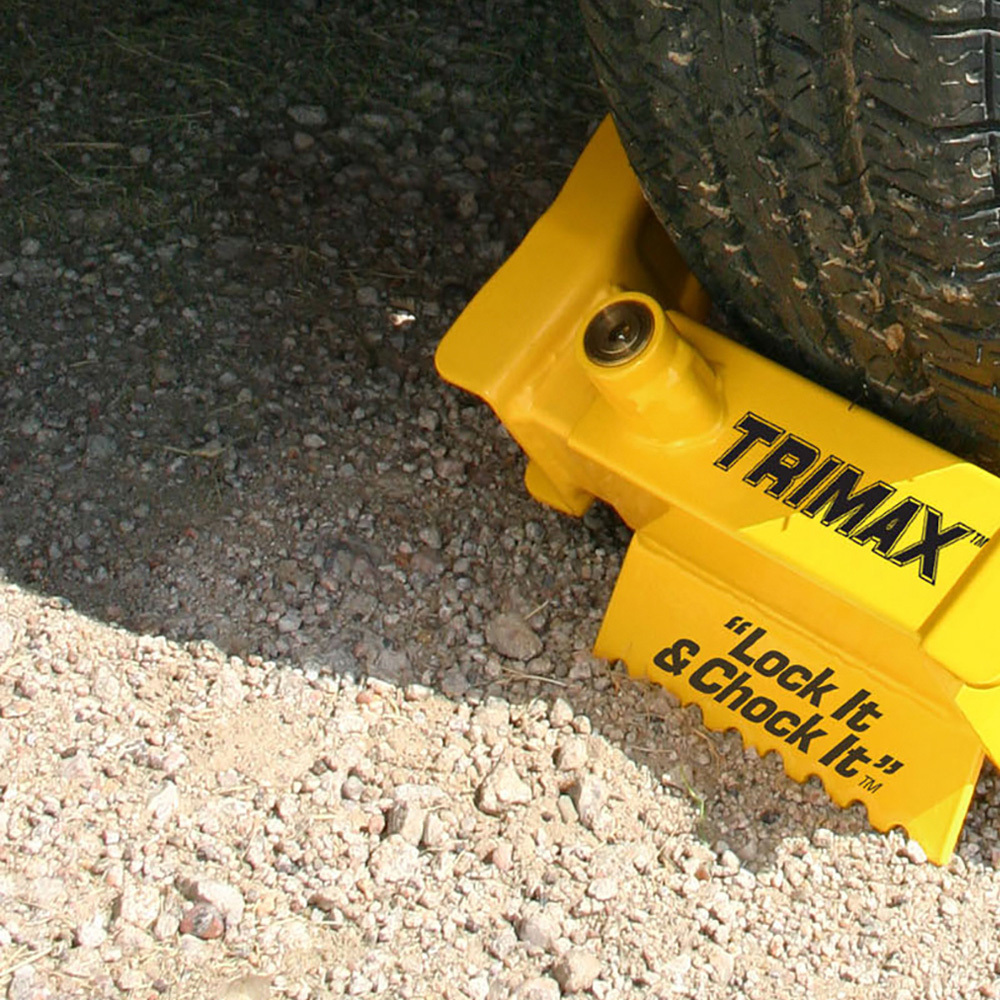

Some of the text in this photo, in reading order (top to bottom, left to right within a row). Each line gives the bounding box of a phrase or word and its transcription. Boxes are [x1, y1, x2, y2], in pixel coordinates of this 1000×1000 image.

[713, 411, 977, 586] TRIMAX
[653, 638, 701, 678] &
[688, 657, 828, 755] Chock
[830, 688, 884, 733] It
